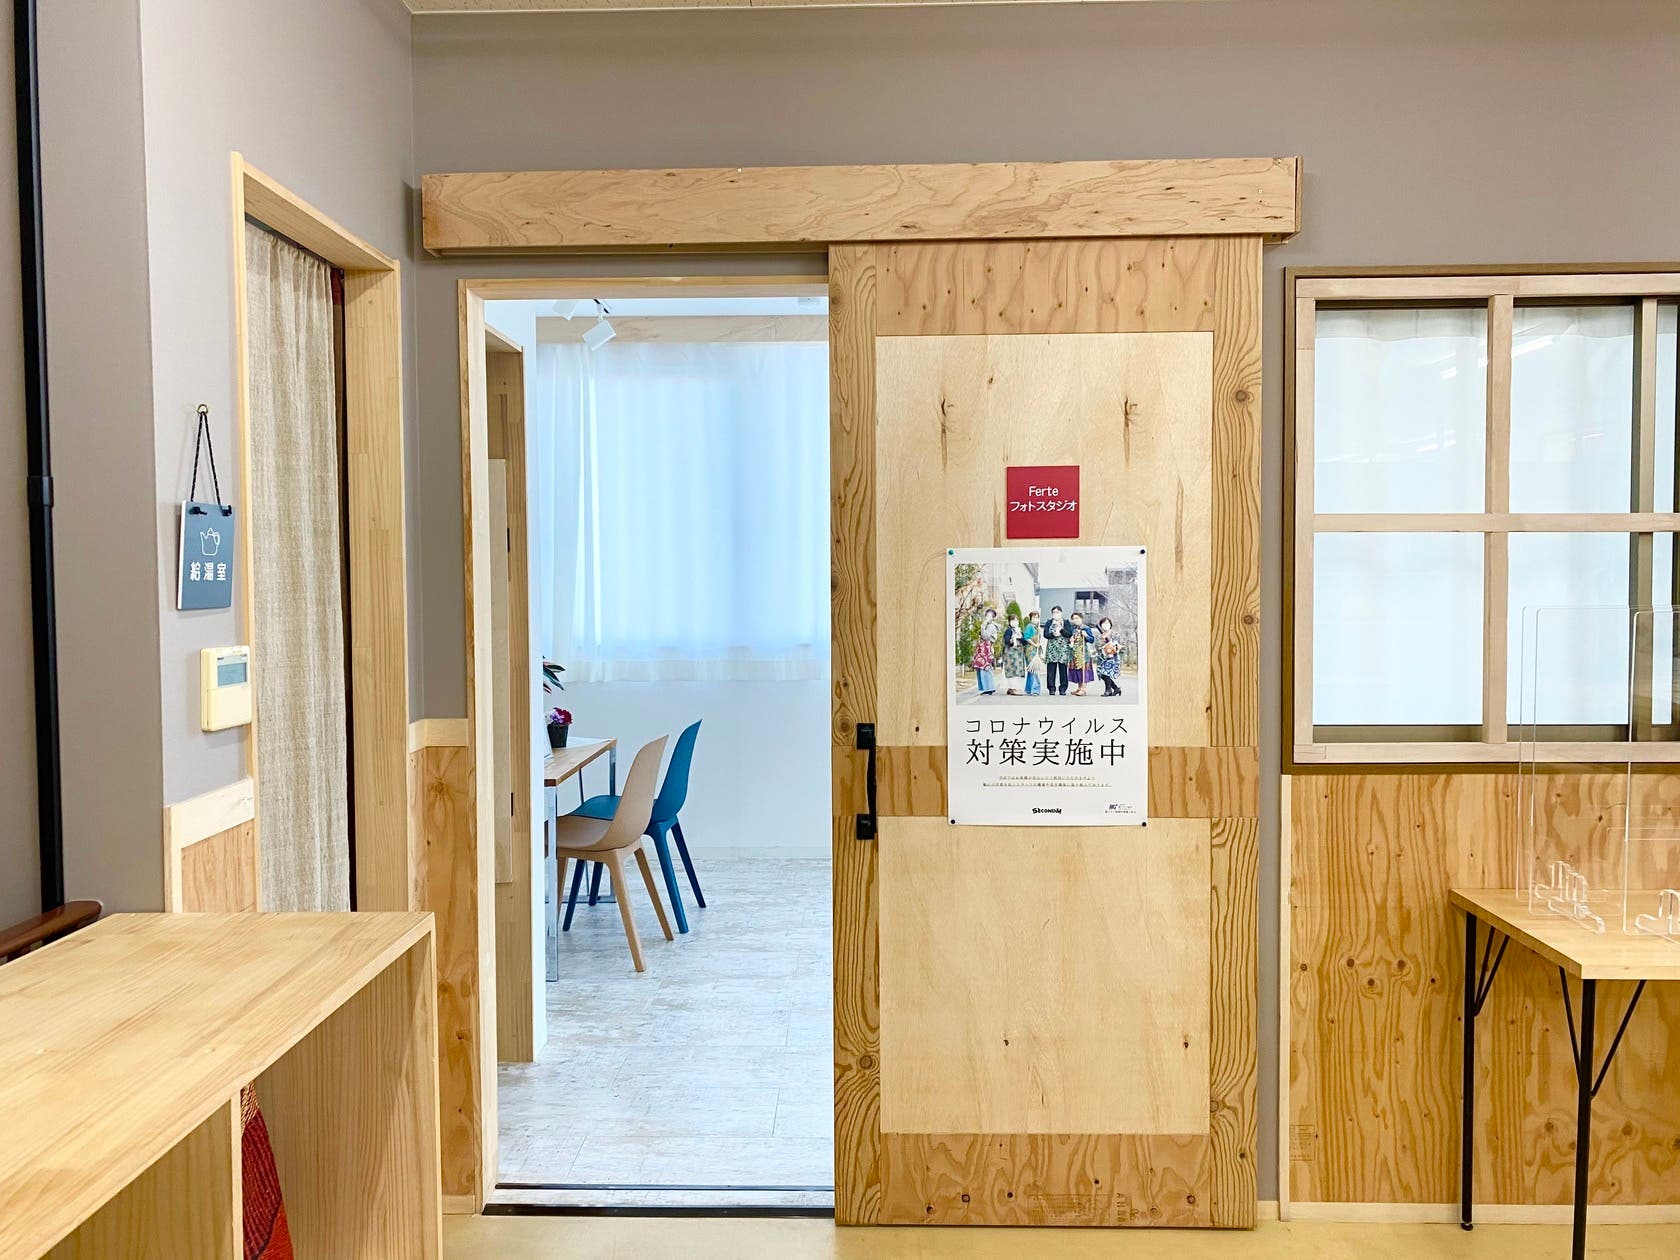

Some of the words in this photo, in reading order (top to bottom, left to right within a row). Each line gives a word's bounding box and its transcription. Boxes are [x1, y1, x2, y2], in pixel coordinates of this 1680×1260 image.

[1028, 486, 1059, 497] Ferte
[1010, 500, 1077, 512] フォトスタジオ
[190, 561, 227, 581] 給湯室
[966, 716, 1128, 735] コロナウイルス
[965, 738, 1126, 767] 対策実施中
